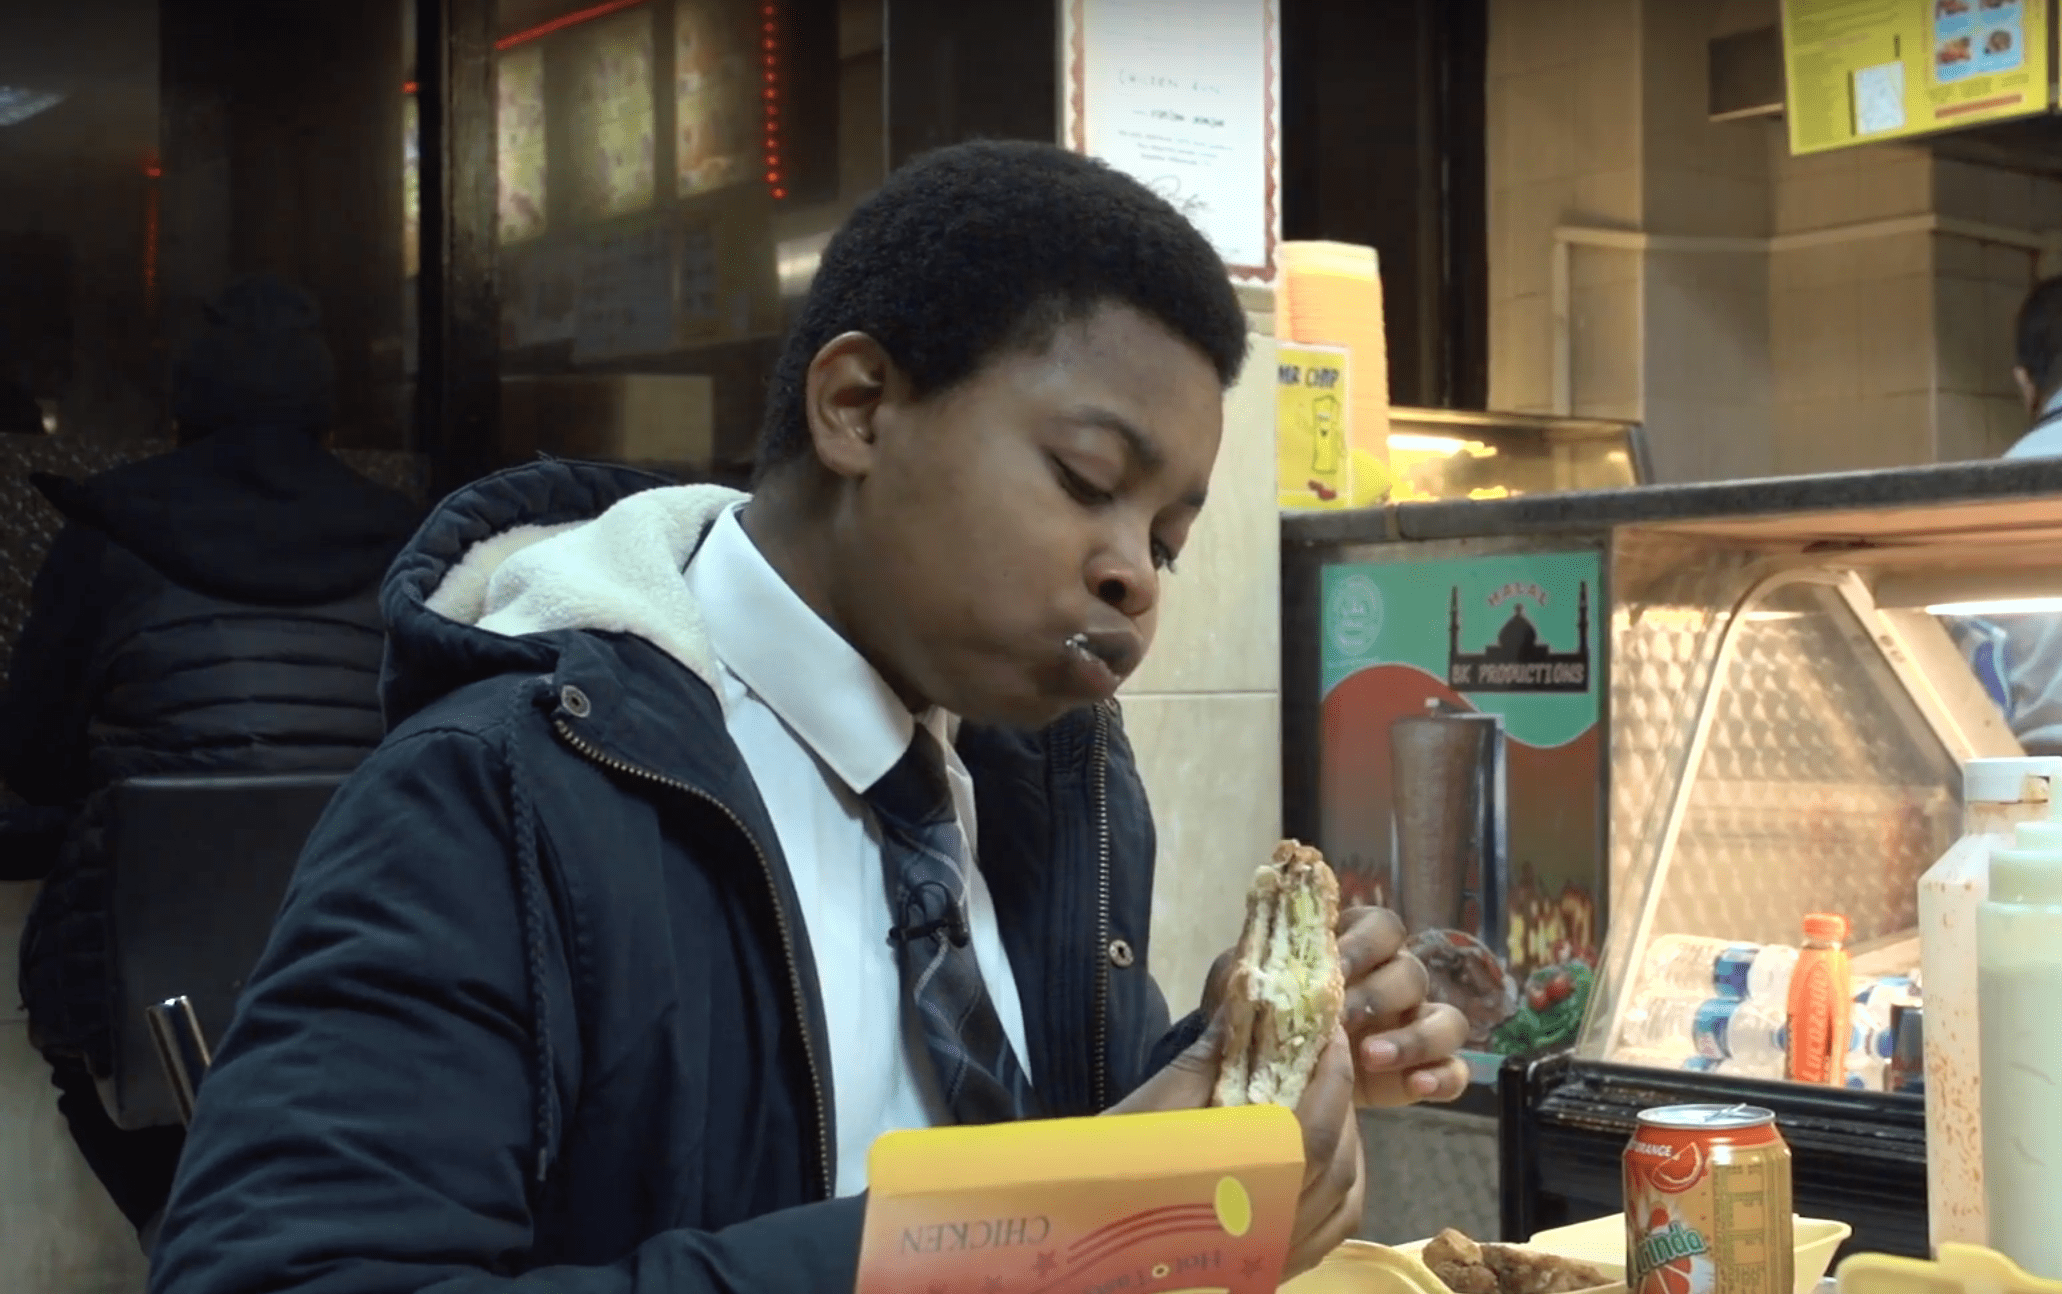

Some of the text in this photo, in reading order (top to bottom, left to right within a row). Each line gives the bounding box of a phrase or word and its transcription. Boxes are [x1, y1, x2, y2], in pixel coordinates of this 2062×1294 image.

[1306, 367, 1340, 388] CHIP
[1488, 582, 1547, 606] HALAL
[1478, 662, 1585, 684] PRODUCTIONS
[900, 1215, 1051, 1254] CHICKEN
